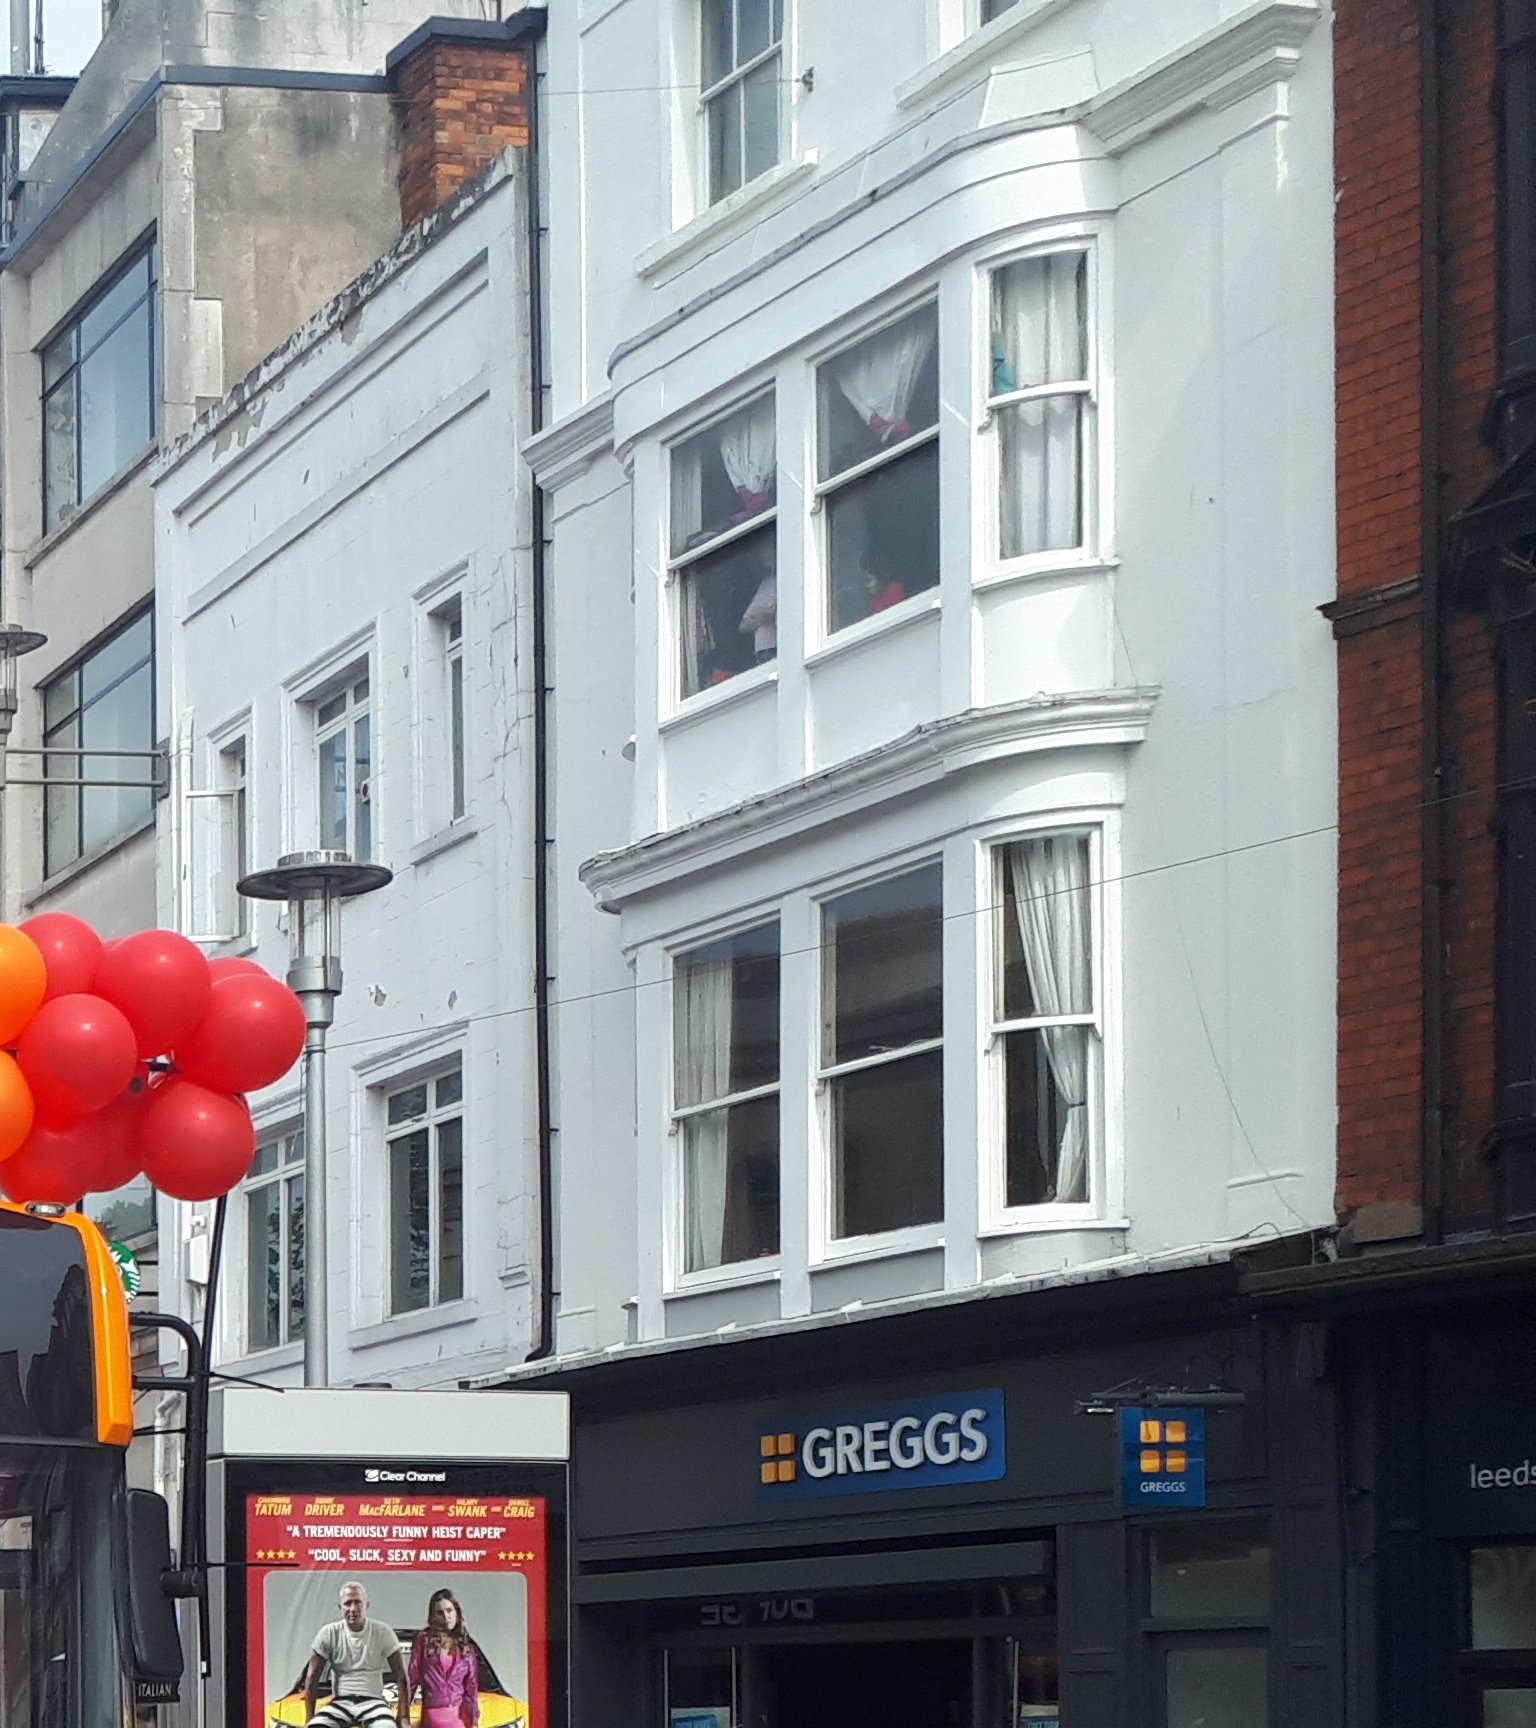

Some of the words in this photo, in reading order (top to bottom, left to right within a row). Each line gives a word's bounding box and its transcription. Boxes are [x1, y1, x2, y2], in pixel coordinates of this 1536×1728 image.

[802, 1408, 988, 1478] GREGGS
[379, 1471, 405, 1482] Clear
[406, 1471, 446, 1482] Channel
[1139, 1481, 1187, 1493] GREGGS
[255, 1503, 293, 1516] TATUM
[304, 1503, 345, 1516] DRIVER
[448, 1505, 488, 1518] SWANK
[503, 1506, 536, 1518] CRAIG
[303, 1525, 388, 1538] TREMENDOUSLY
[393, 1526, 429, 1538] FUNNY
[432, 1527, 462, 1539] HEIST
[349, 1549, 384, 1563] SLICK,
[387, 1550, 415, 1562] SEXY
[419, 1550, 442, 1562] AND
[138, 1682, 172, 1697] ITALIAN
